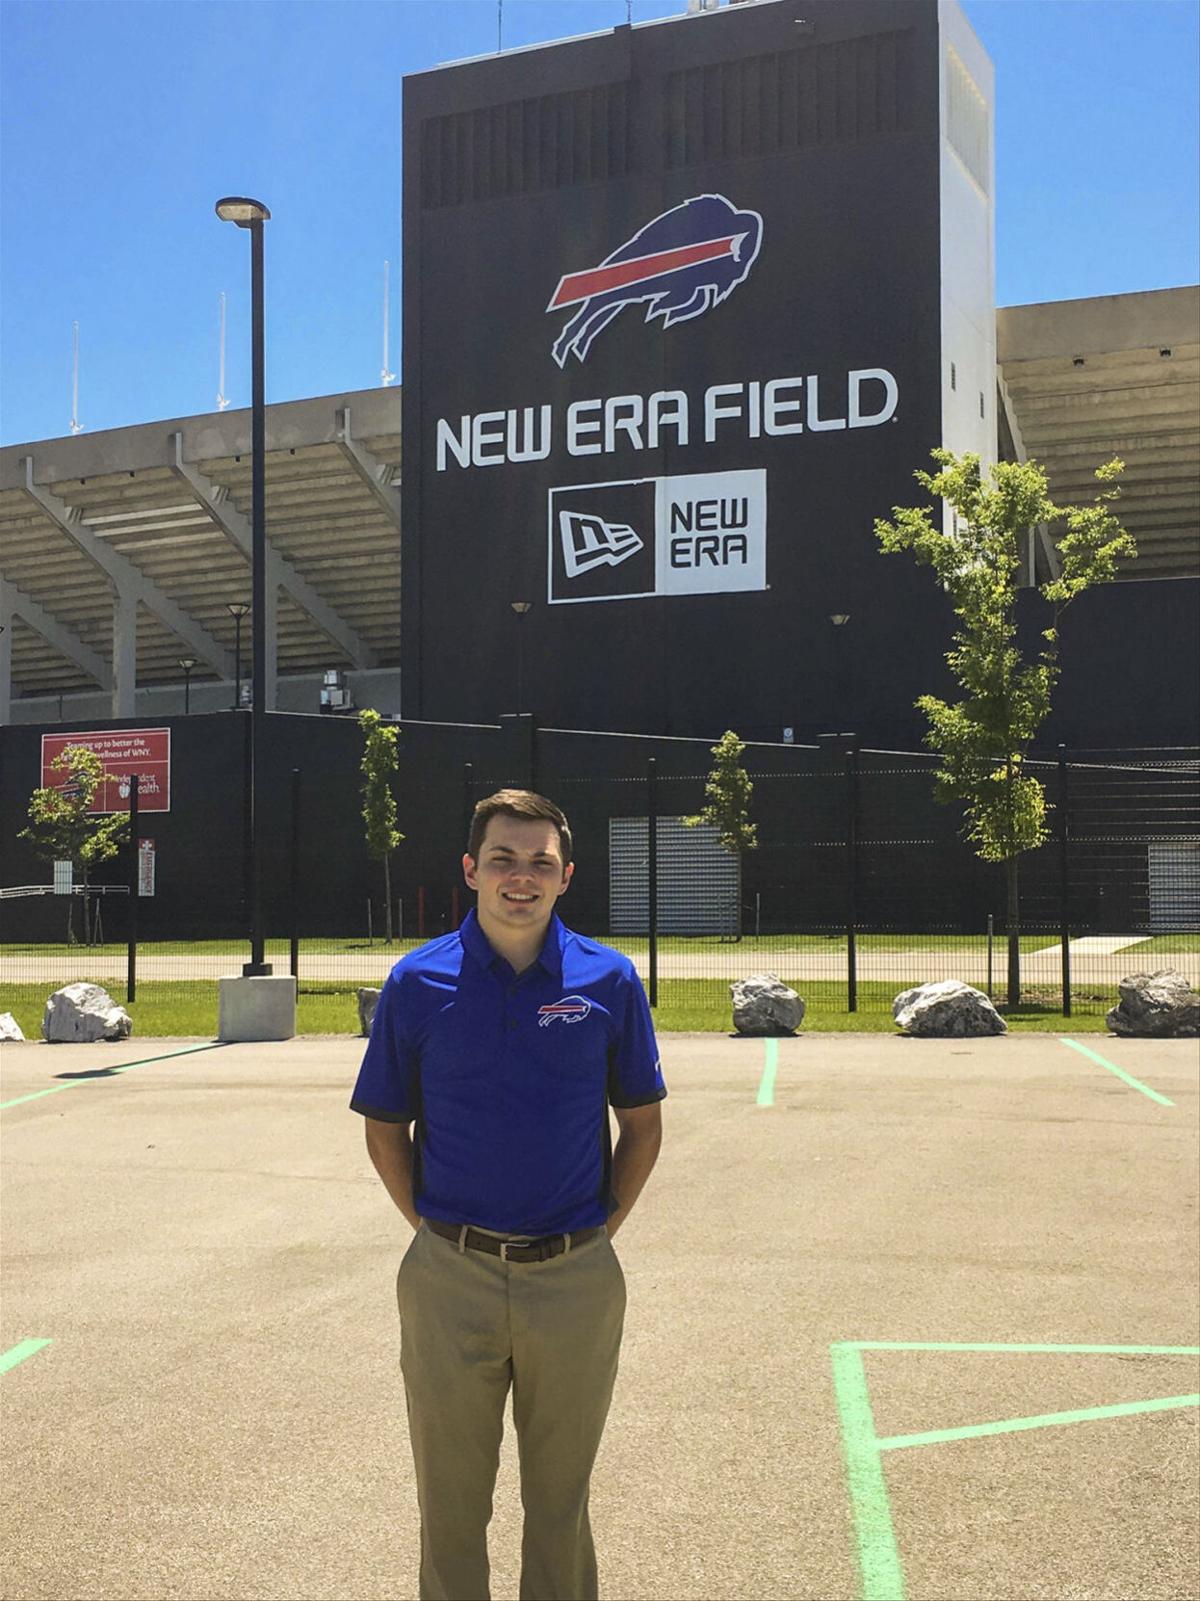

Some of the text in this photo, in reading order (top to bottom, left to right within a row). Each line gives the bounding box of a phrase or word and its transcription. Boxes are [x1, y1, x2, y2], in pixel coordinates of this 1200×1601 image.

[436, 367, 899, 471] NEW ERA FIELD
[670, 497, 749, 534] NEW
[670, 533, 748, 569] ERA
[94, 742, 103, 750] up
[112, 739, 133, 748] better
[133, 738, 145, 747] the
[123, 748, 131, 757] of
